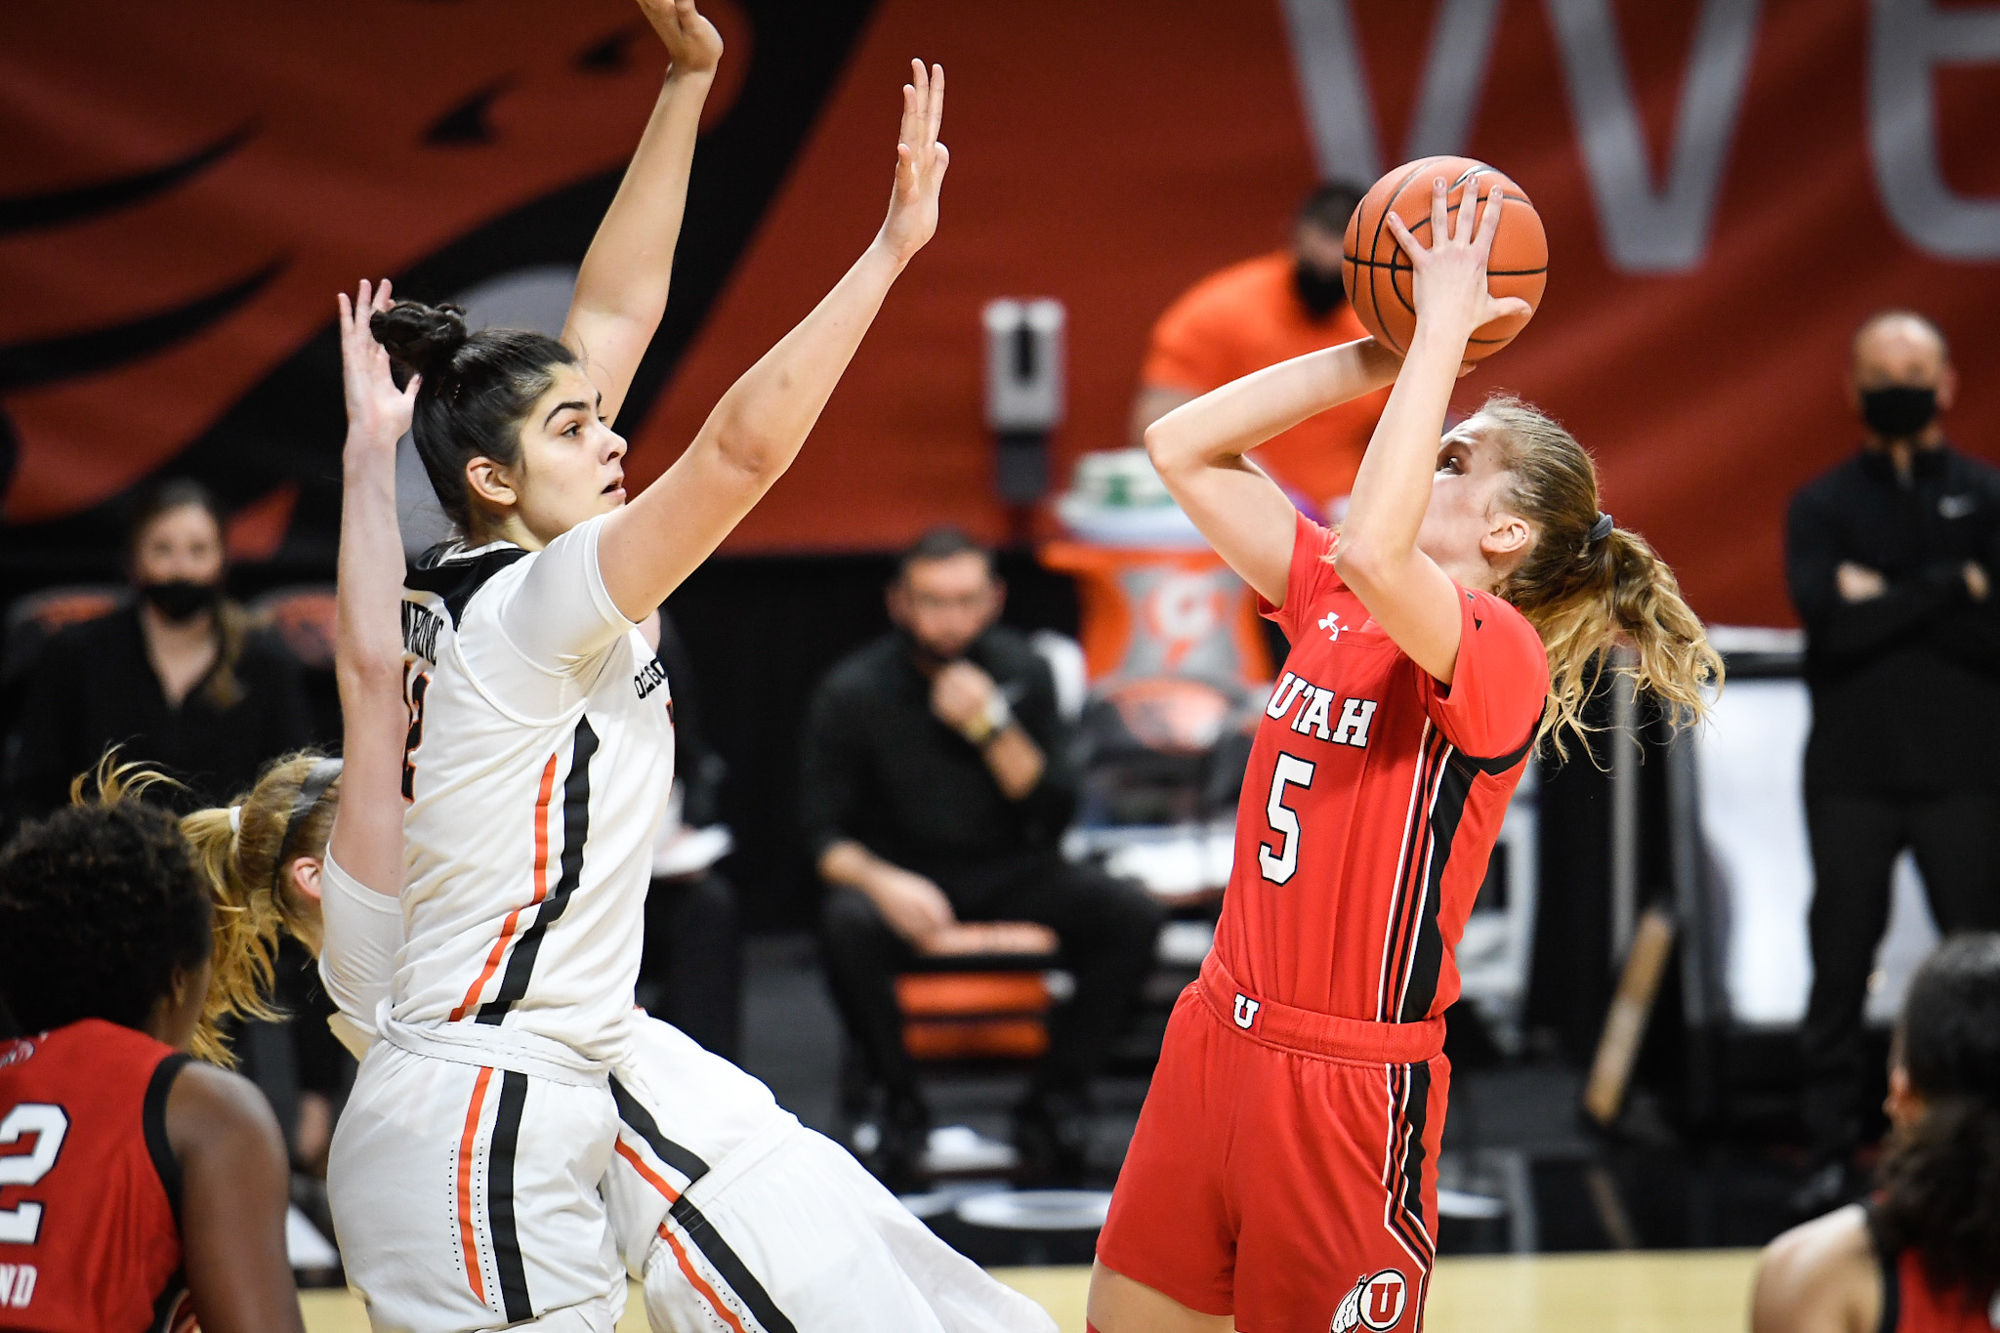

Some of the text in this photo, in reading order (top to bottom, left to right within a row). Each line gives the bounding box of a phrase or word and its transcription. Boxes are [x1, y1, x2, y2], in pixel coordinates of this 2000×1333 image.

[1265, 670, 1378, 749] UTAH
[1257, 750, 1317, 887] 5
[1232, 992, 1261, 1030] U
[1368, 1282, 1403, 1324] U
